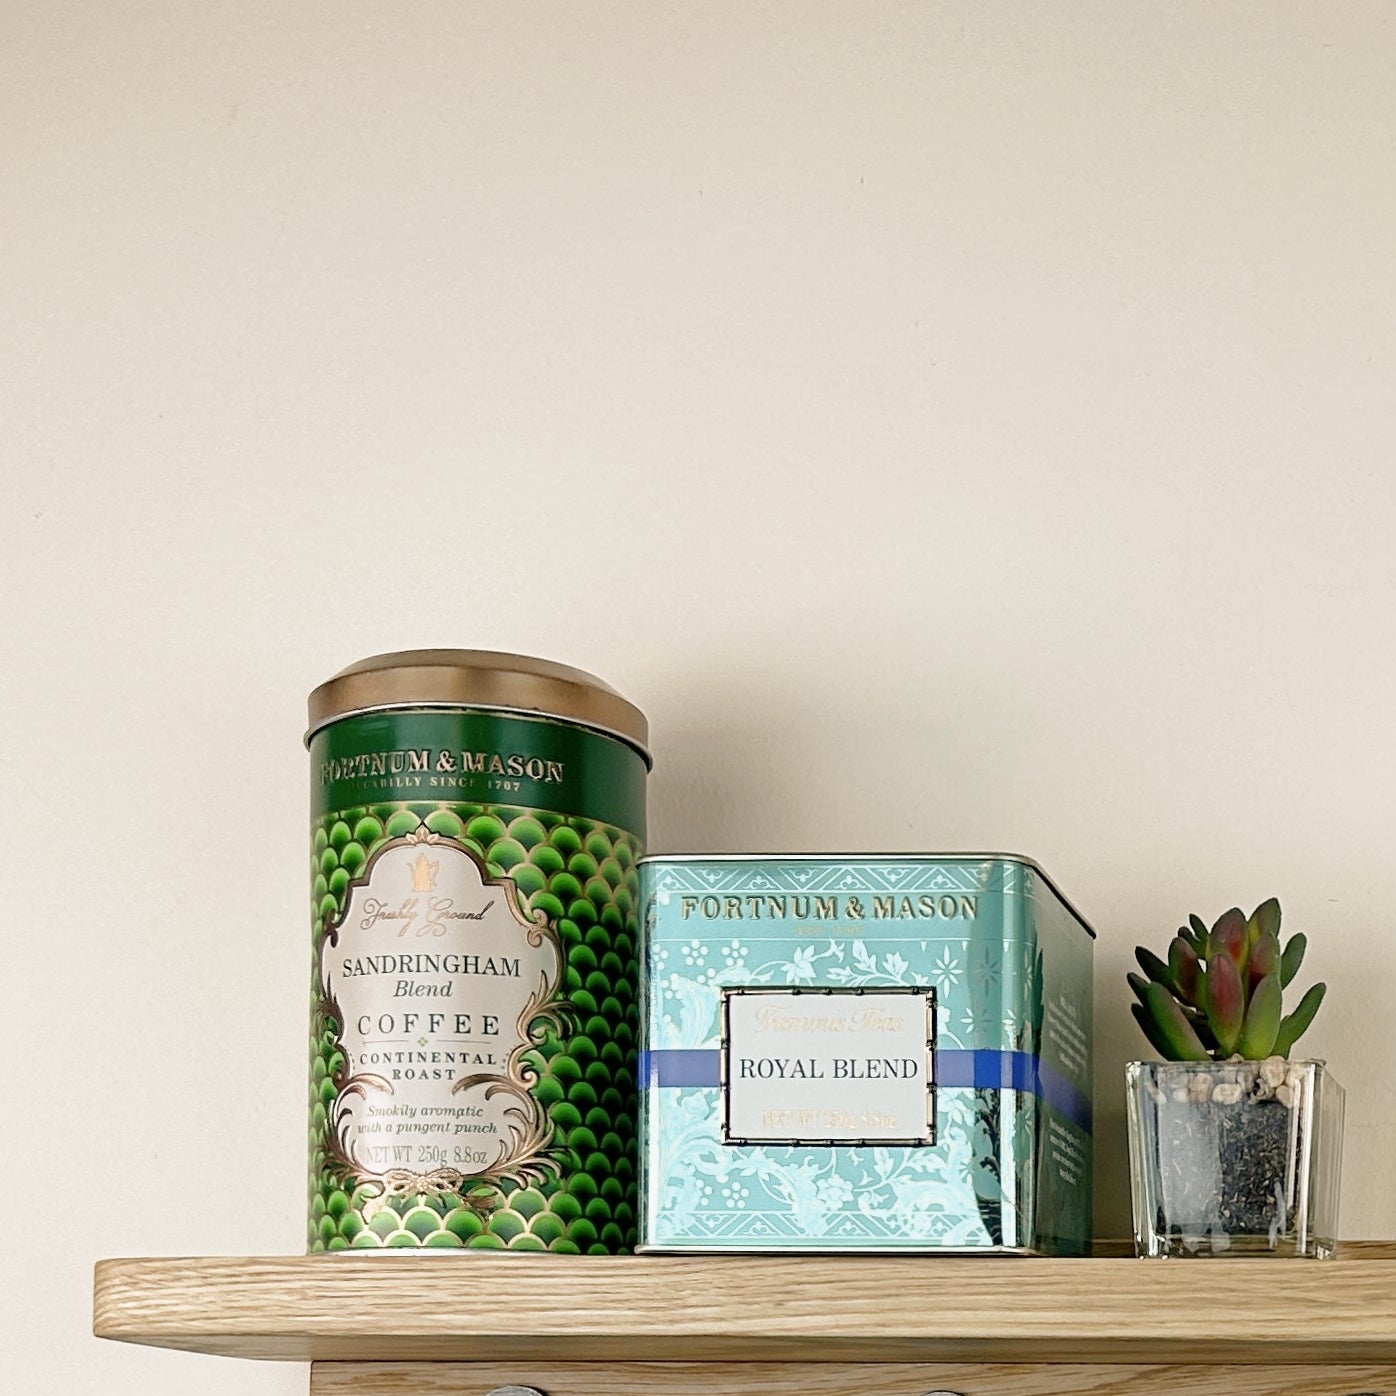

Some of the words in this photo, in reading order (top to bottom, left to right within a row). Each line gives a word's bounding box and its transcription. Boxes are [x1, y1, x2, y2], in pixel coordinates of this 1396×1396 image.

[435, 750, 457, 773] &
[461, 751, 565, 784] MASON
[416, 896, 495, 937] Ground
[680, 895, 838, 920] FORTNUM
[844, 896, 866, 920] &
[871, 895, 979, 920] MASON
[342, 953, 522, 978] SANDRINGHAM
[393, 980, 453, 998] Blend
[357, 1013, 500, 1036] COFFEE
[359, 1051, 497, 1066] CONTINENTAL
[740, 1058, 824, 1079] ROYAL
[832, 1058, 918, 1079] BLEND
[392, 1068, 457, 1081] ROAST
[368, 1104, 418, 1119] Smokily
[420, 1106, 484, 1120] aromatic
[357, 1122, 382, 1134] with
[385, 1124, 393, 1133] a
[396, 1122, 450, 1135] pungent
[453, 1122, 498, 1135] punch
[392, 1145, 413, 1163] WT
[417, 1145, 448, 1168] 250g
[453, 1146, 488, 1164] 8.8oz
